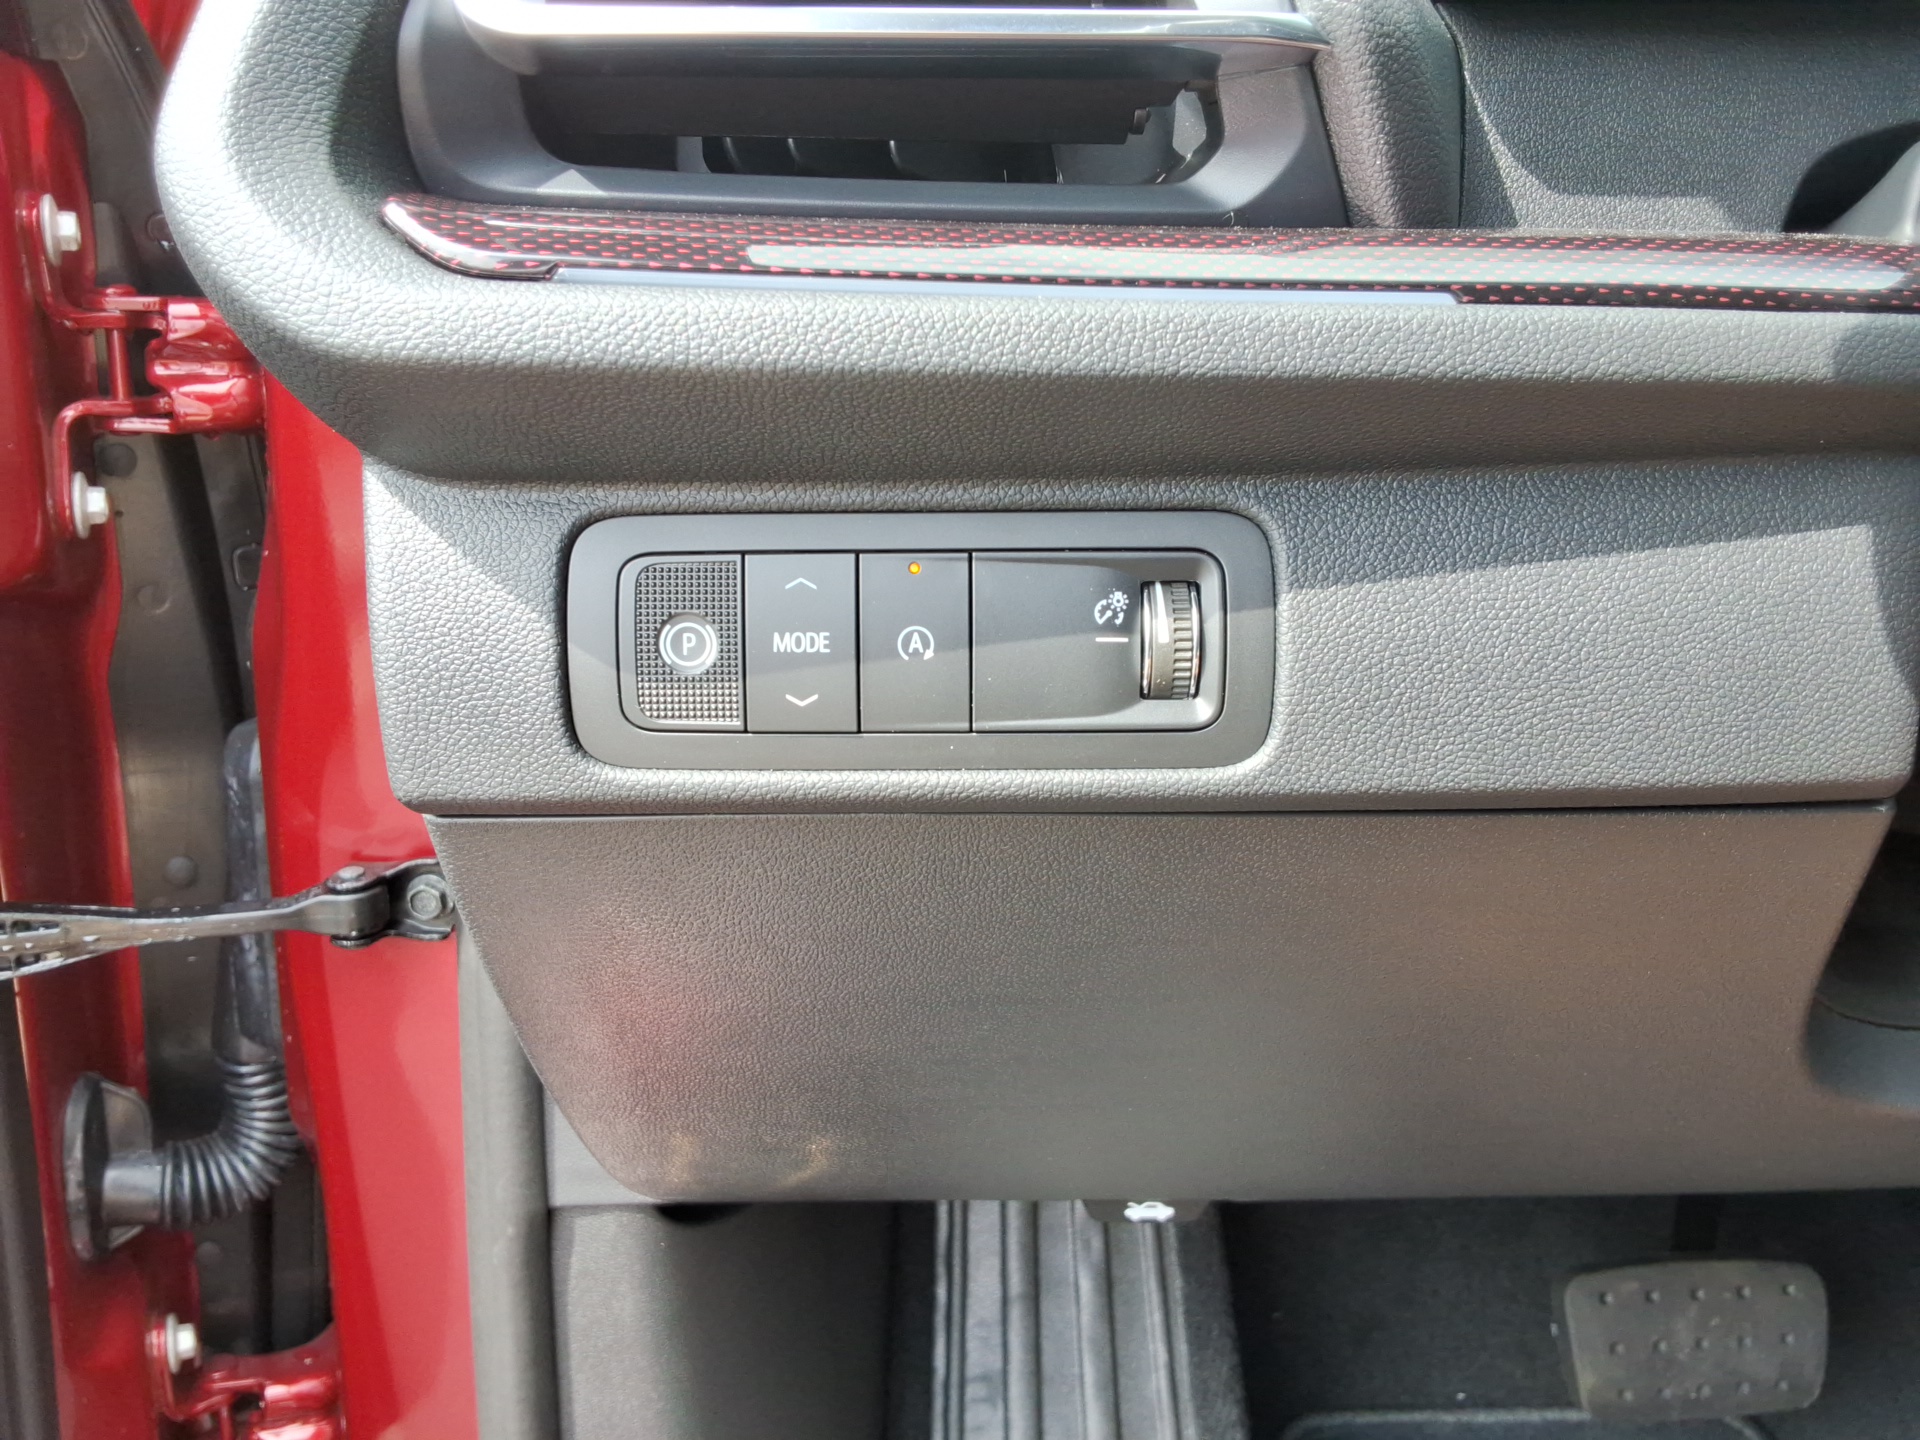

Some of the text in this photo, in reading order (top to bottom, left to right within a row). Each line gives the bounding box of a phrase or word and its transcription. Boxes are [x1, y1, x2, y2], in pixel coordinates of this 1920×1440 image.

[683, 633, 696, 655] P
[773, 632, 831, 653] MODE
[908, 632, 924, 653] A
